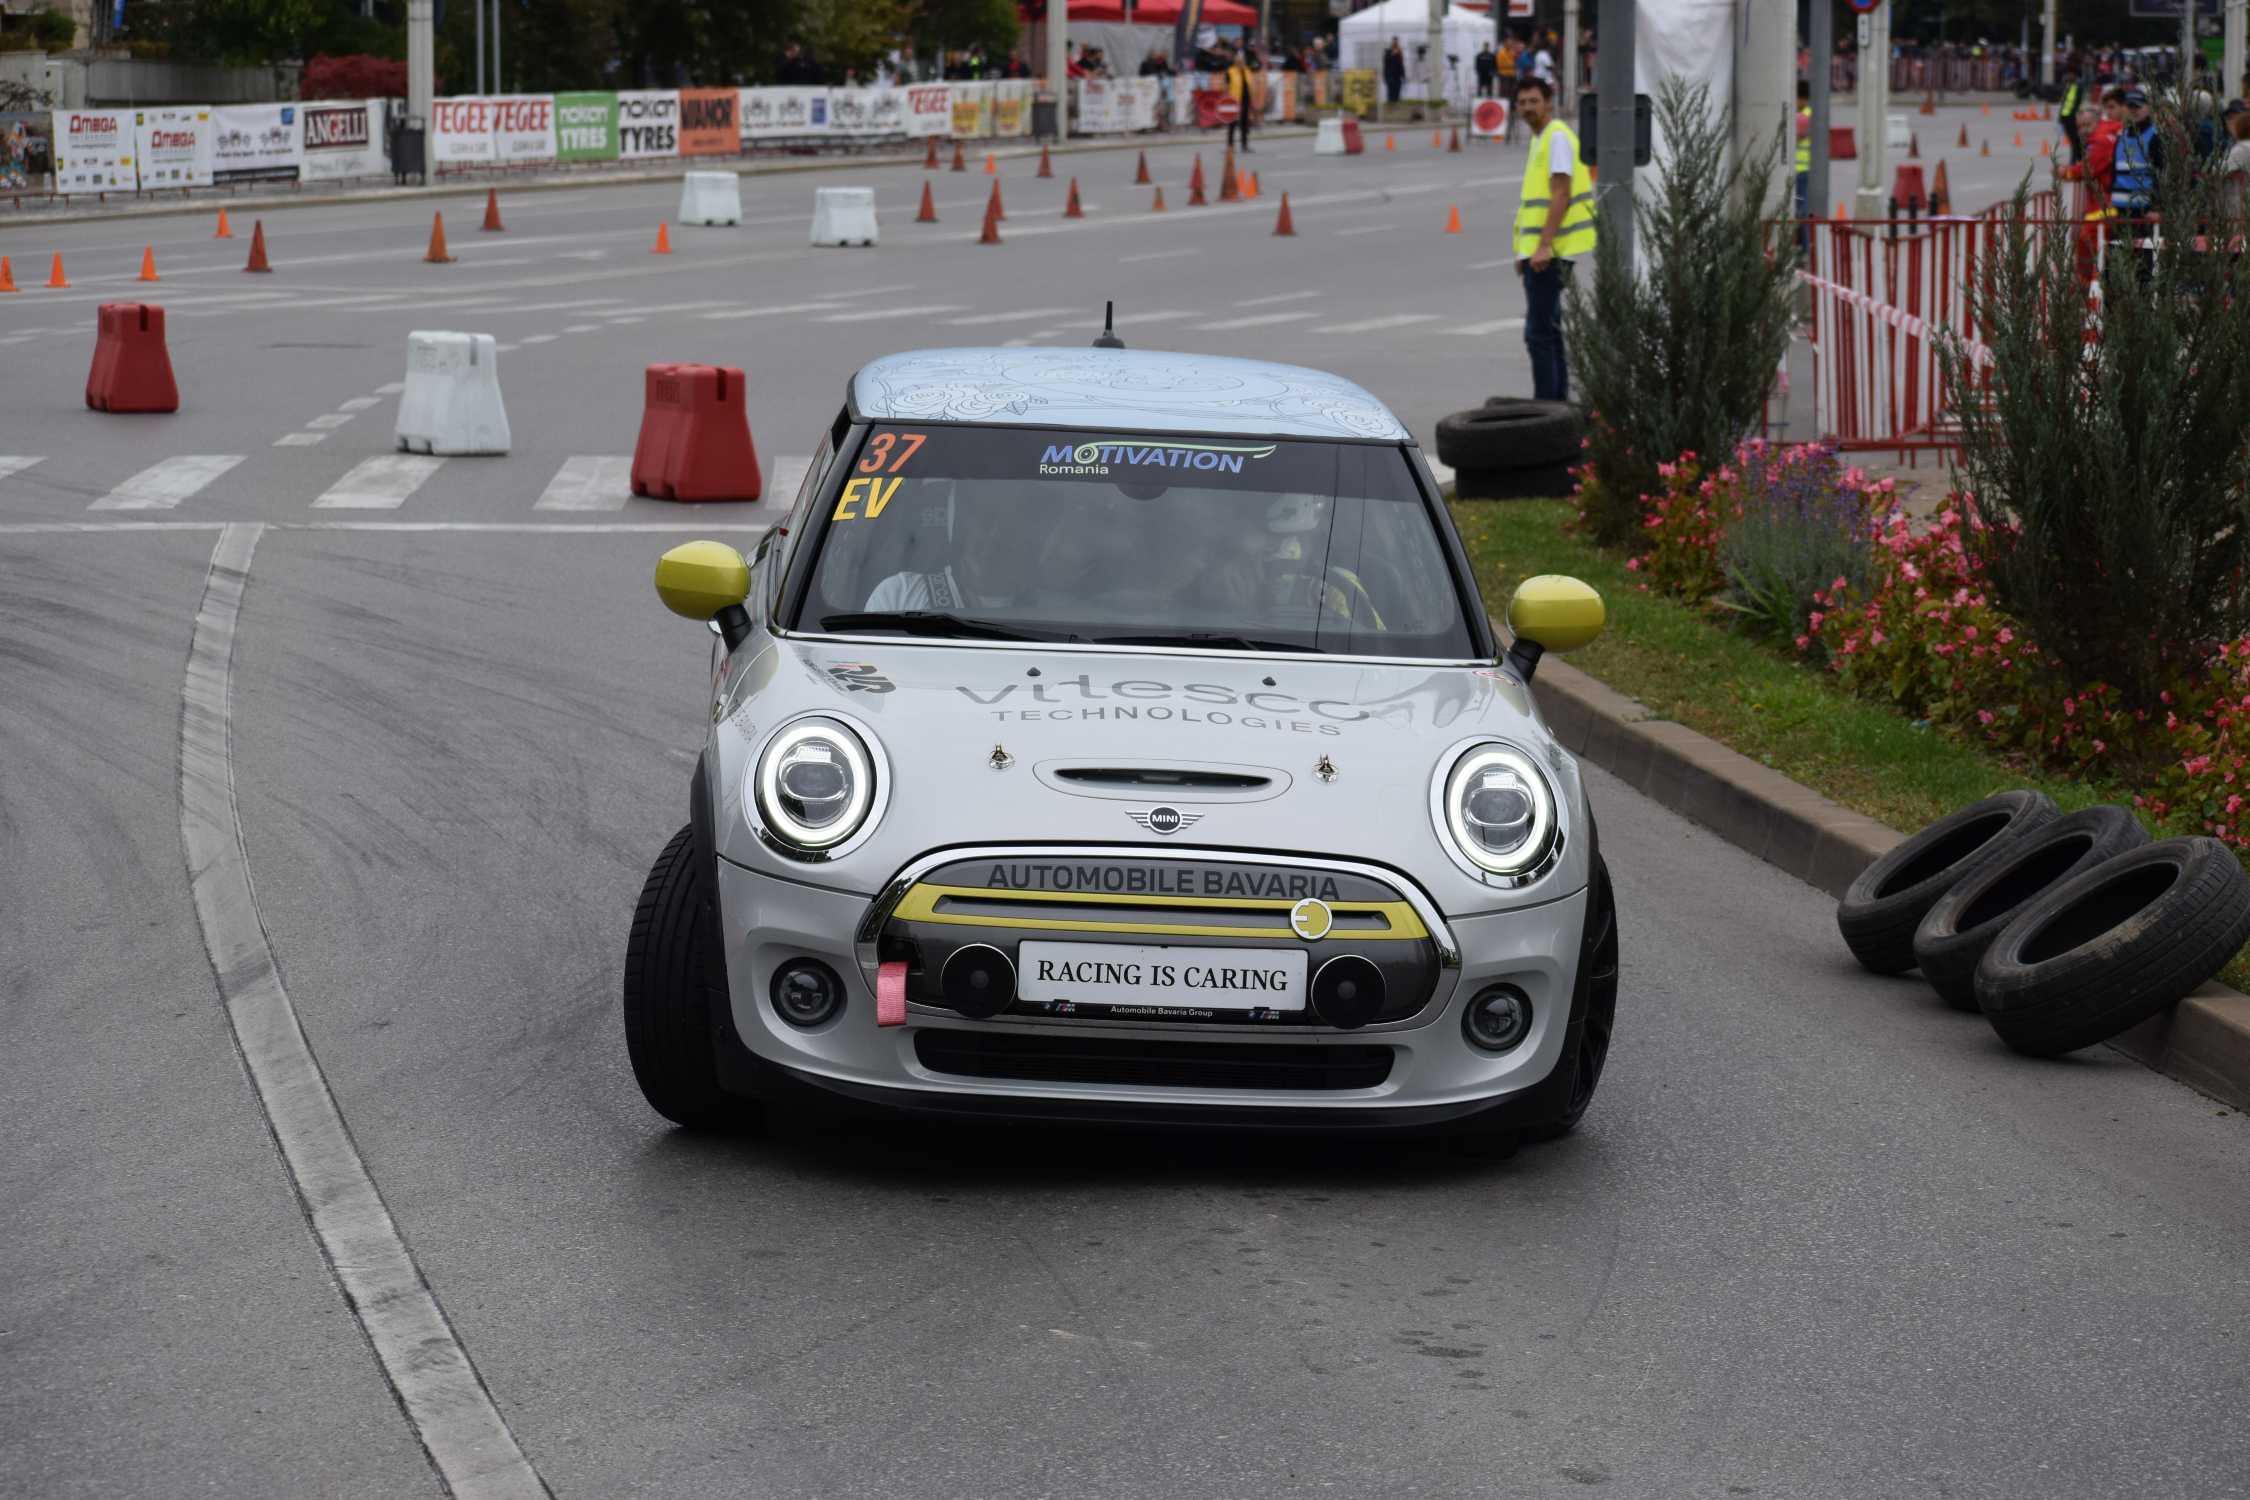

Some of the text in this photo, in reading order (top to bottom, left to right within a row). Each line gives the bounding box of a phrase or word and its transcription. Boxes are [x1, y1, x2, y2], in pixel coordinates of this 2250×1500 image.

[306, 111, 367, 144] ANGELLI
[560, 127, 608, 150] TYRES
[619, 125, 676, 152] TYRES
[859, 433, 927, 473] 37
[1040, 445, 1244, 474] MOTIVATION
[1039, 463, 1110, 475] Romania
[831, 476, 904, 522] EV
[955, 673, 1371, 722] vitesco
[991, 706, 1342, 737] TECHNOLOGIES
[1151, 814, 1178, 823] MINI
[987, 863, 1340, 901] AUTOMOBILE BAVARIA
[1037, 960, 1289, 991] RACING IS CARING
[1110, 1005, 1213, 1017] Automobile Bavaria Group
